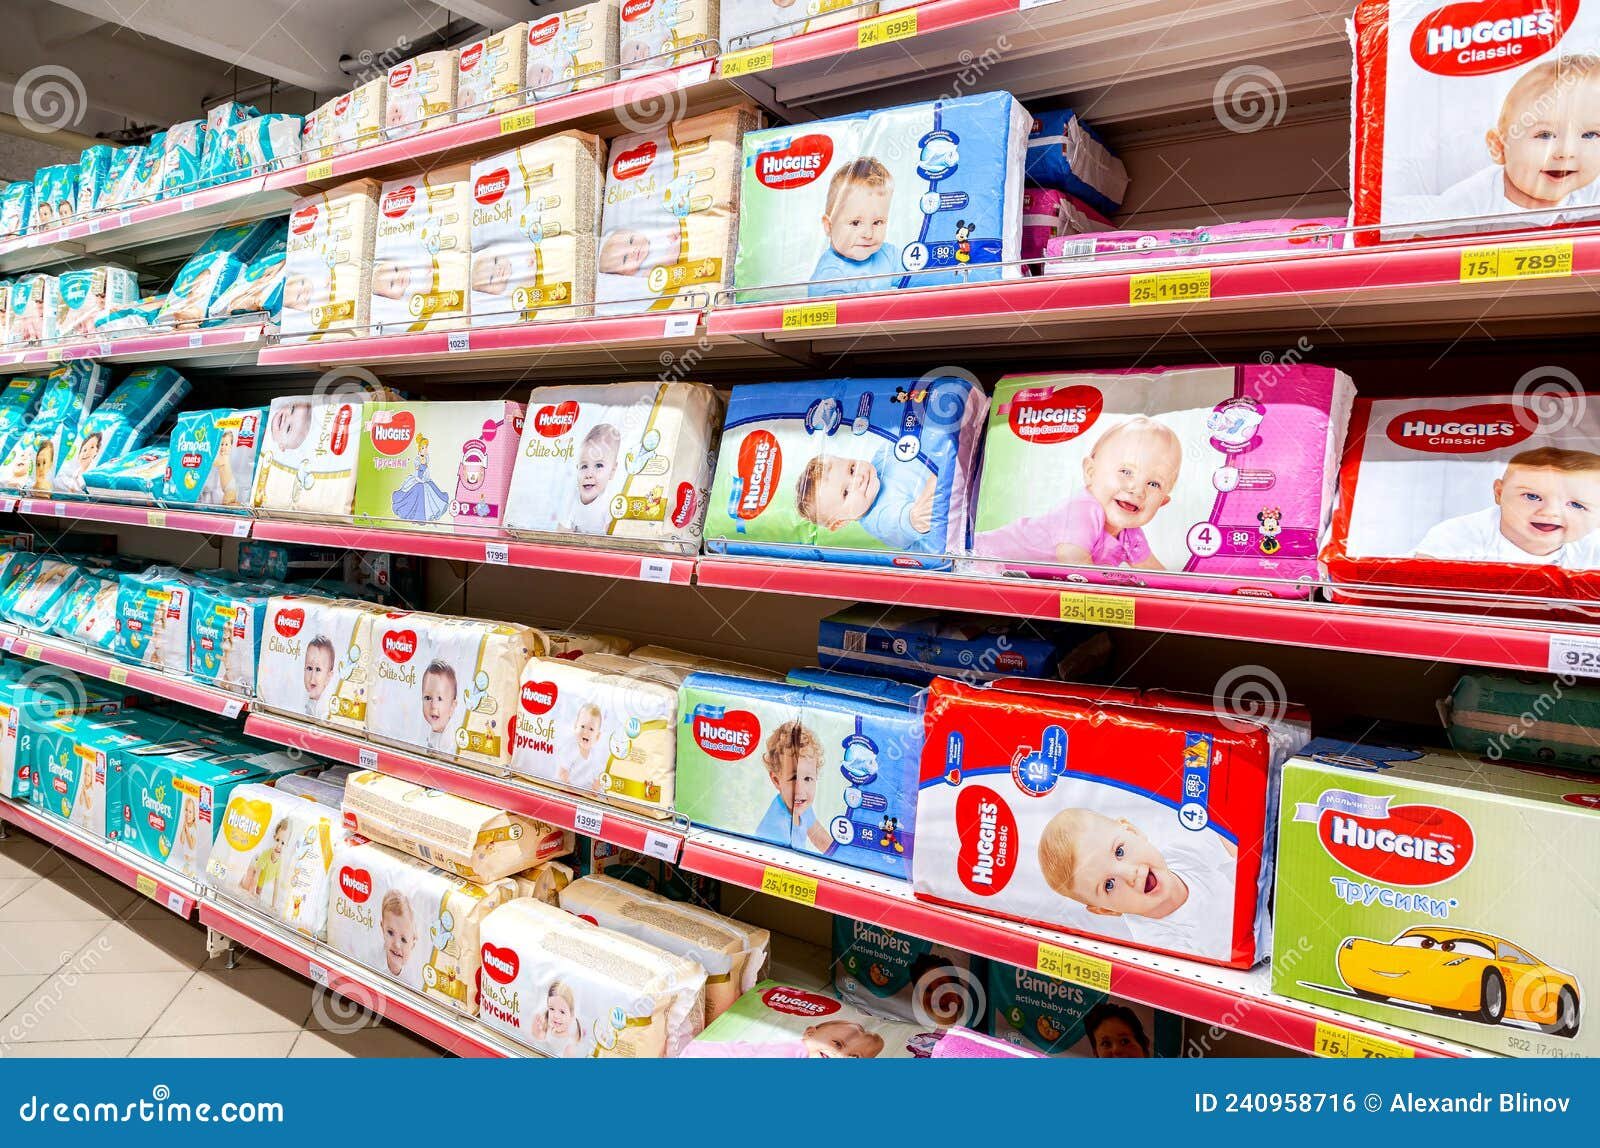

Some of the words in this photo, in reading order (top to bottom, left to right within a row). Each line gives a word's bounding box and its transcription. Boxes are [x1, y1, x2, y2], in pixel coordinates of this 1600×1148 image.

[886, 21, 909, 36] 699
[1427, 12, 1555, 55] HUGGIES
[746, 55, 767, 68] 699
[1457, 43, 1523, 65] Classic
[617, 155, 651, 173] HUGGIES
[763, 153, 822, 174] HUGGIES
[472, 207, 493, 227] Elite
[493, 202, 513, 222] Soft
[909, 246, 921, 261] 4
[936, 246, 950, 256] 80
[1514, 254, 1558, 271] 789
[654, 269, 663, 283] 2
[1159, 282, 1200, 297] 1199
[802, 311, 829, 324] 1199
[539, 413, 574, 426] HUGGIES
[1017, 405, 1088, 425] HUGGIES
[374, 425, 411, 442] HUGGIES
[1040, 422, 1080, 435] Comfort
[1402, 421, 1515, 438] HUGGIES
[525, 438, 550, 459] Elite
[551, 436, 574, 462] Soft
[898, 440, 912, 454] 4
[1428, 436, 1486, 446] Classic
[742, 440, 771, 511] HUGGIES
[615, 497, 623, 510] 3
[1198, 527, 1213, 544] 4
[1232, 531, 1249, 542] 80
[487, 551, 504, 560] 1799
[1087, 606, 1125, 619] 1199
[277, 617, 301, 629] HUGGIES
[268, 635, 286, 654] Elite
[385, 638, 413, 654] HUGGIES
[378, 662, 398, 681] Elite
[398, 665, 416, 688] Soft
[522, 688, 552, 706] HUGGIES
[534, 717, 556, 744] Soft
[699, 722, 751, 745] HUGGIES
[48, 755, 73, 782] Pampers
[1028, 762, 1043, 781] 12
[141, 786, 172, 819] Pampers
[576, 813, 596, 828] 1399
[1183, 809, 1198, 822] 4
[838, 820, 848, 834] 5
[862, 827, 874, 838] 64
[971, 801, 998, 886] HUGGIES
[995, 824, 1009, 868] Classic
[1331, 815, 1456, 867] HUGGIES
[342, 874, 369, 896] HUGGIES
[782, 882, 809, 898] 1199
[336, 897, 355, 921] Elite
[355, 908, 374, 930] Soft
[853, 919, 911, 954] Pampers
[484, 950, 515, 977] HUGGIES
[848, 955, 856, 969] 6
[852, 943, 874, 957] active
[874, 950, 909, 968] baby-dry
[1064, 963, 1101, 982] 1199
[1015, 967, 1084, 1005] Pampers
[499, 985, 520, 1014] Soft
[769, 991, 826, 1014] HUGGIES
[1015, 994, 1040, 1007] active
[1040, 999, 1082, 1019] baby-dry
[1011, 1007, 1020, 1021] 6
[1508, 1036, 1531, 1052] SR22
